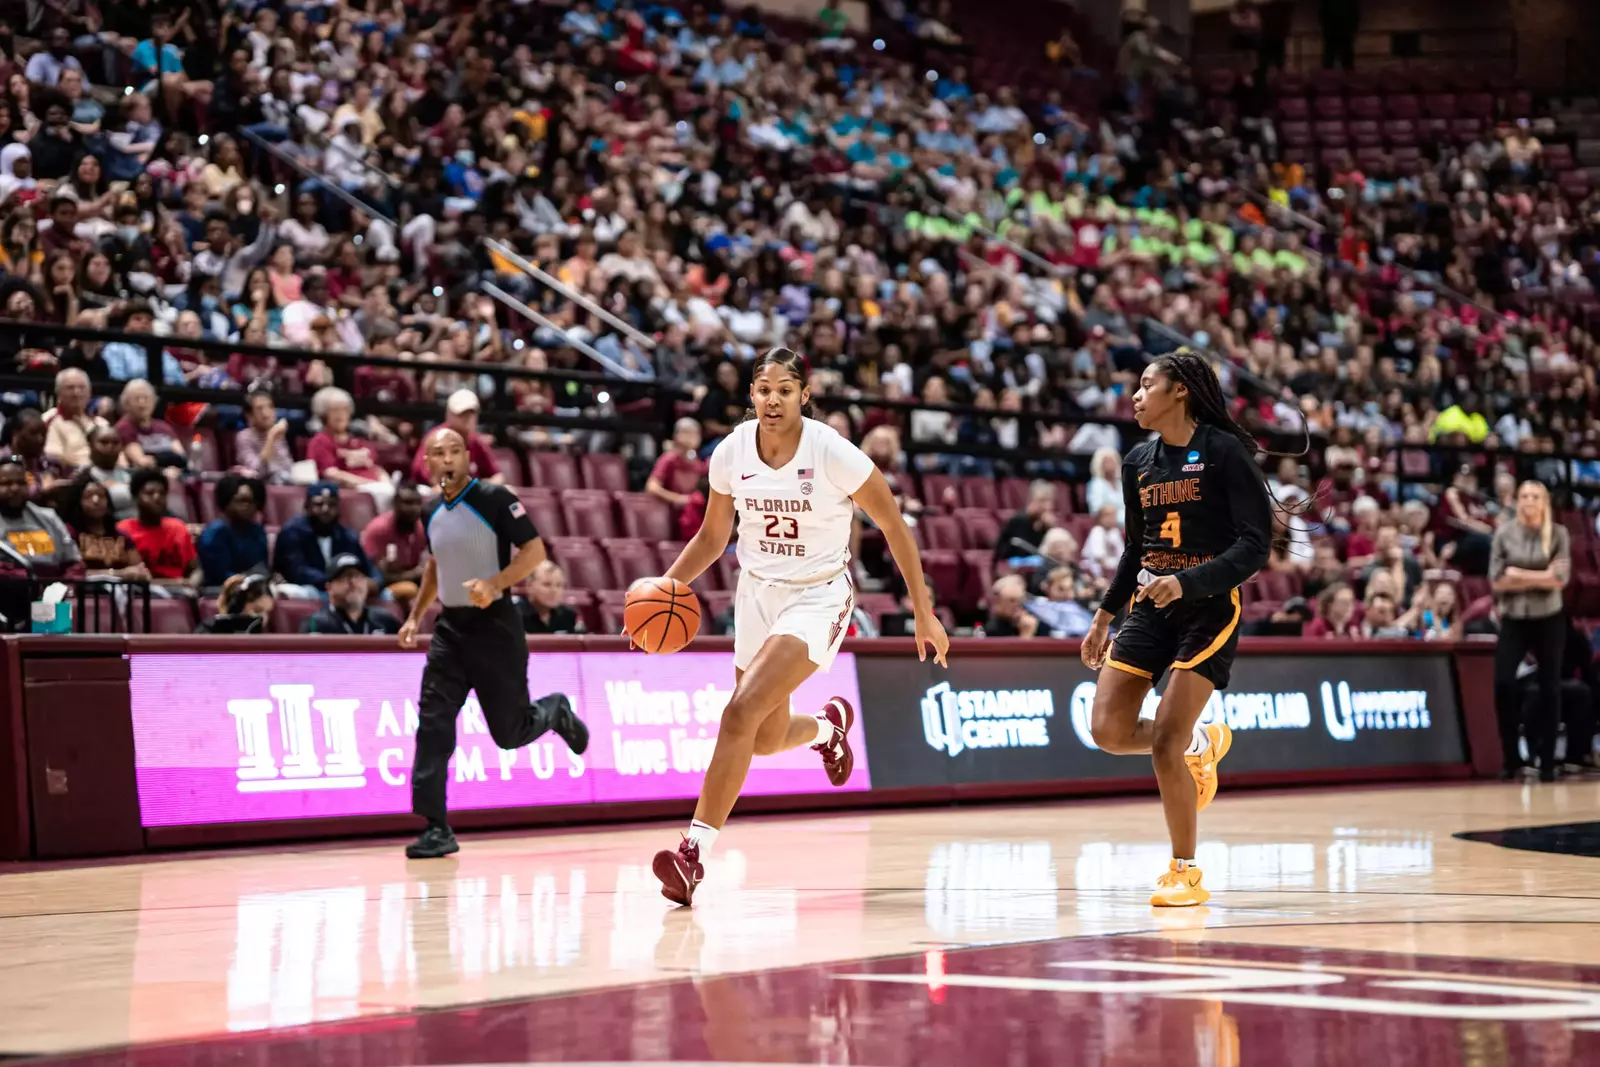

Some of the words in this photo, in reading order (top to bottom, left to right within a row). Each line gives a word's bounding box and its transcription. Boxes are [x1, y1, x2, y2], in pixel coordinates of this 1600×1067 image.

[745, 498, 813, 513] FLORIDA
[763, 514, 799, 539] 23
[1160, 511, 1181, 548] 4
[758, 540, 806, 557] STATE
[605, 680, 690, 725] Where
[958, 689, 1054, 718] STADIUM
[1224, 692, 1310, 730] COPELAND
[962, 718, 1050, 748] CENTRE
[378, 743, 585, 787] CMPUS
[612, 730, 668, 775] love
[670, 728, 717, 773] livi
